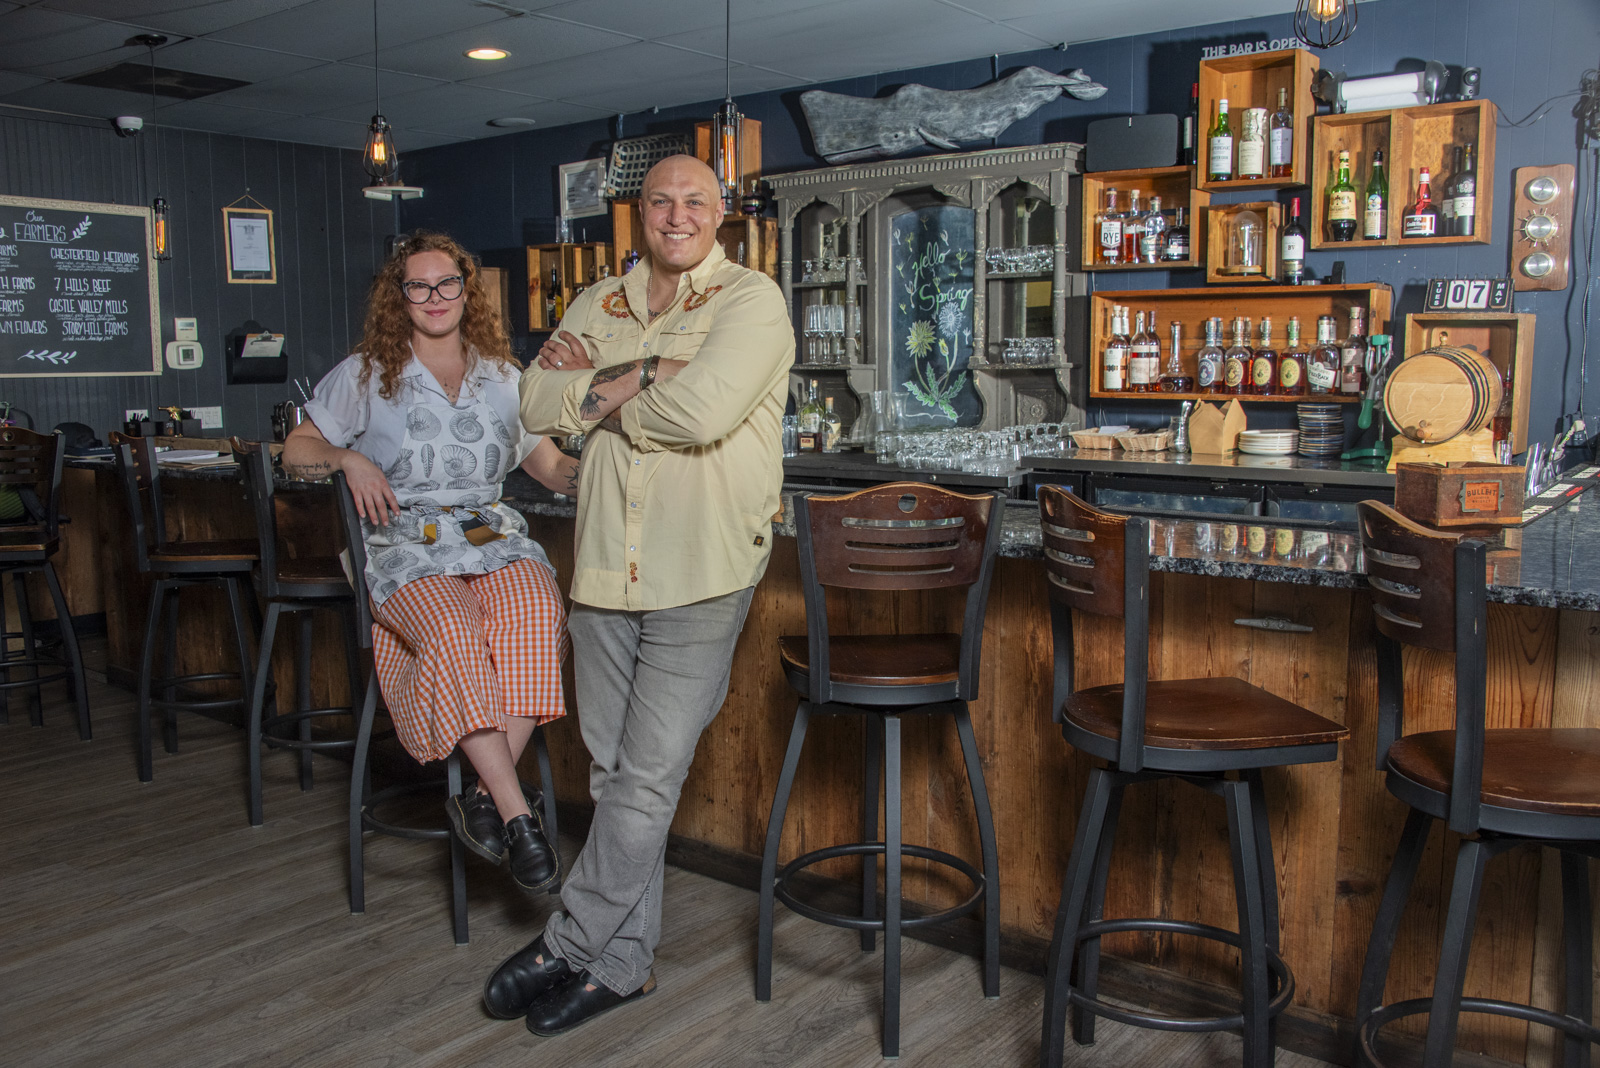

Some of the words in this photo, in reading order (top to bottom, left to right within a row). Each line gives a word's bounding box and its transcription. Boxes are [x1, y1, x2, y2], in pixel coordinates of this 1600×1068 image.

[1202, 45, 1227, 58] THE
[1229, 42, 1253, 55] BAR
[1256, 40, 1267, 52] IS
[26, 210, 45, 222] Our
[14, 223, 66, 242] FARMERS
[1103, 232, 1119, 245] RYE
[50, 247, 100, 261] CHESTERFIELD
[103, 251, 140, 264] HEIRLOOMS
[911, 241, 951, 290] Hello
[12, 277, 35, 290] FARMS
[54, 277, 61, 291] 7
[64, 277, 90, 292] HILLS
[92, 279, 112, 293] BEEF
[919, 285, 974, 315] Spring
[1433, 282, 1443, 306] TUES
[1452, 284, 1486, 304] 07
[1495, 283, 1506, 304] MAY
[48, 298, 76, 313] CASTLE
[77, 300, 103, 314] VALLEY
[105, 300, 128, 314] MILLS
[15, 320, 48, 335] FLOWERS
[104, 321, 128, 336] FARMS
[1467, 489, 1497, 497] BULLEIT
